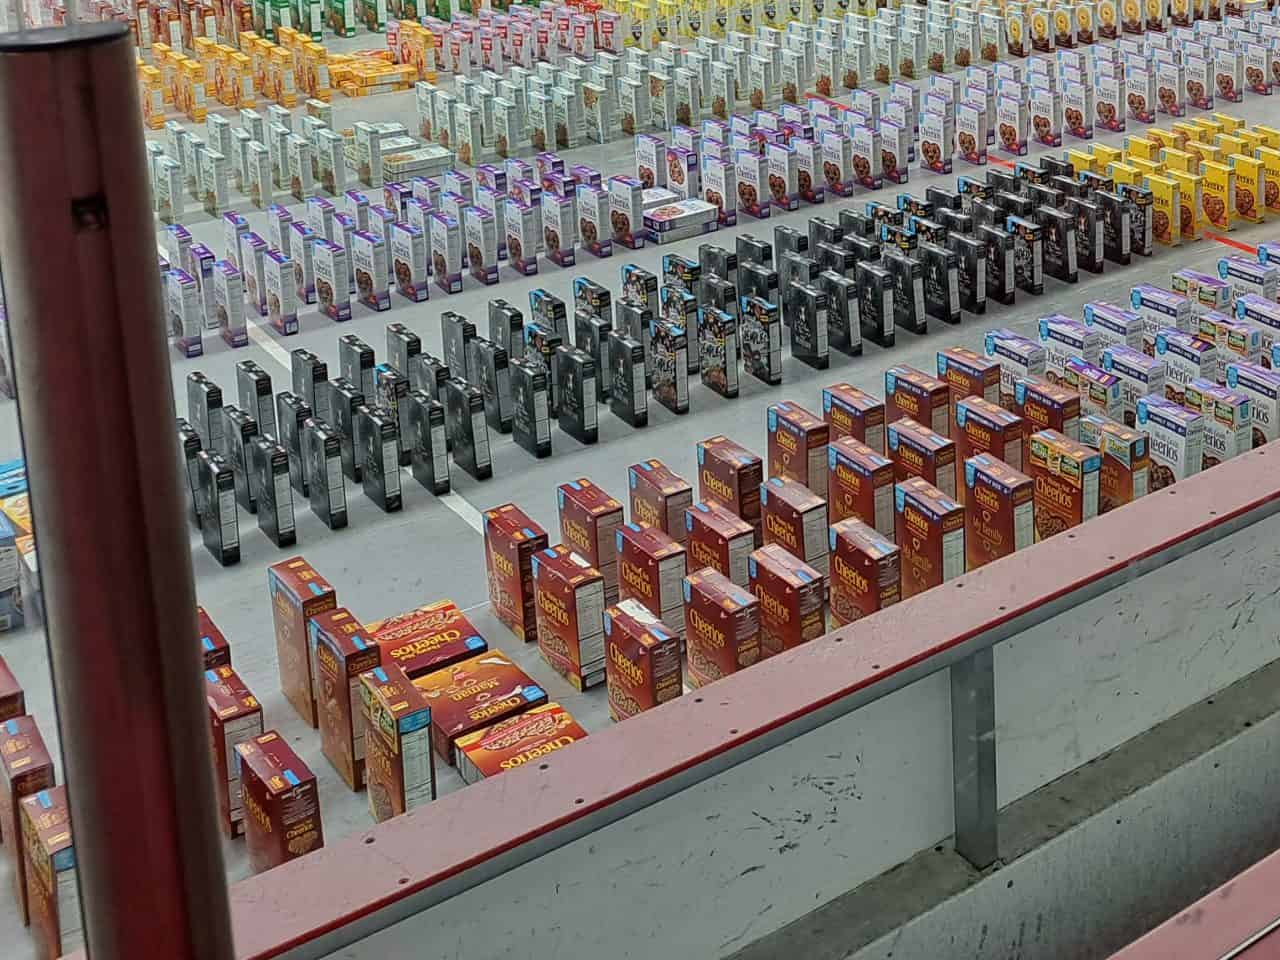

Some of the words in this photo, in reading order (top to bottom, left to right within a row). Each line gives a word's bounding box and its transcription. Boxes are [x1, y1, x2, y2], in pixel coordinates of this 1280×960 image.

[703, 469, 734, 501] Cheerios
[1036, 475, 1073, 508] Cheerios
[767, 513, 797, 549] Cheerios
[622, 559, 653, 598] Cheerios
[835, 555, 868, 593] Cheerios
[538, 589, 570, 626] Cheerios
[755, 583, 790, 622] Cheerios
[390, 629, 461, 659] Cheerios
[690, 608, 725, 648] Cheerios
[610, 642, 644, 685] Cheerios
[469, 696, 521, 722] Cheerios
